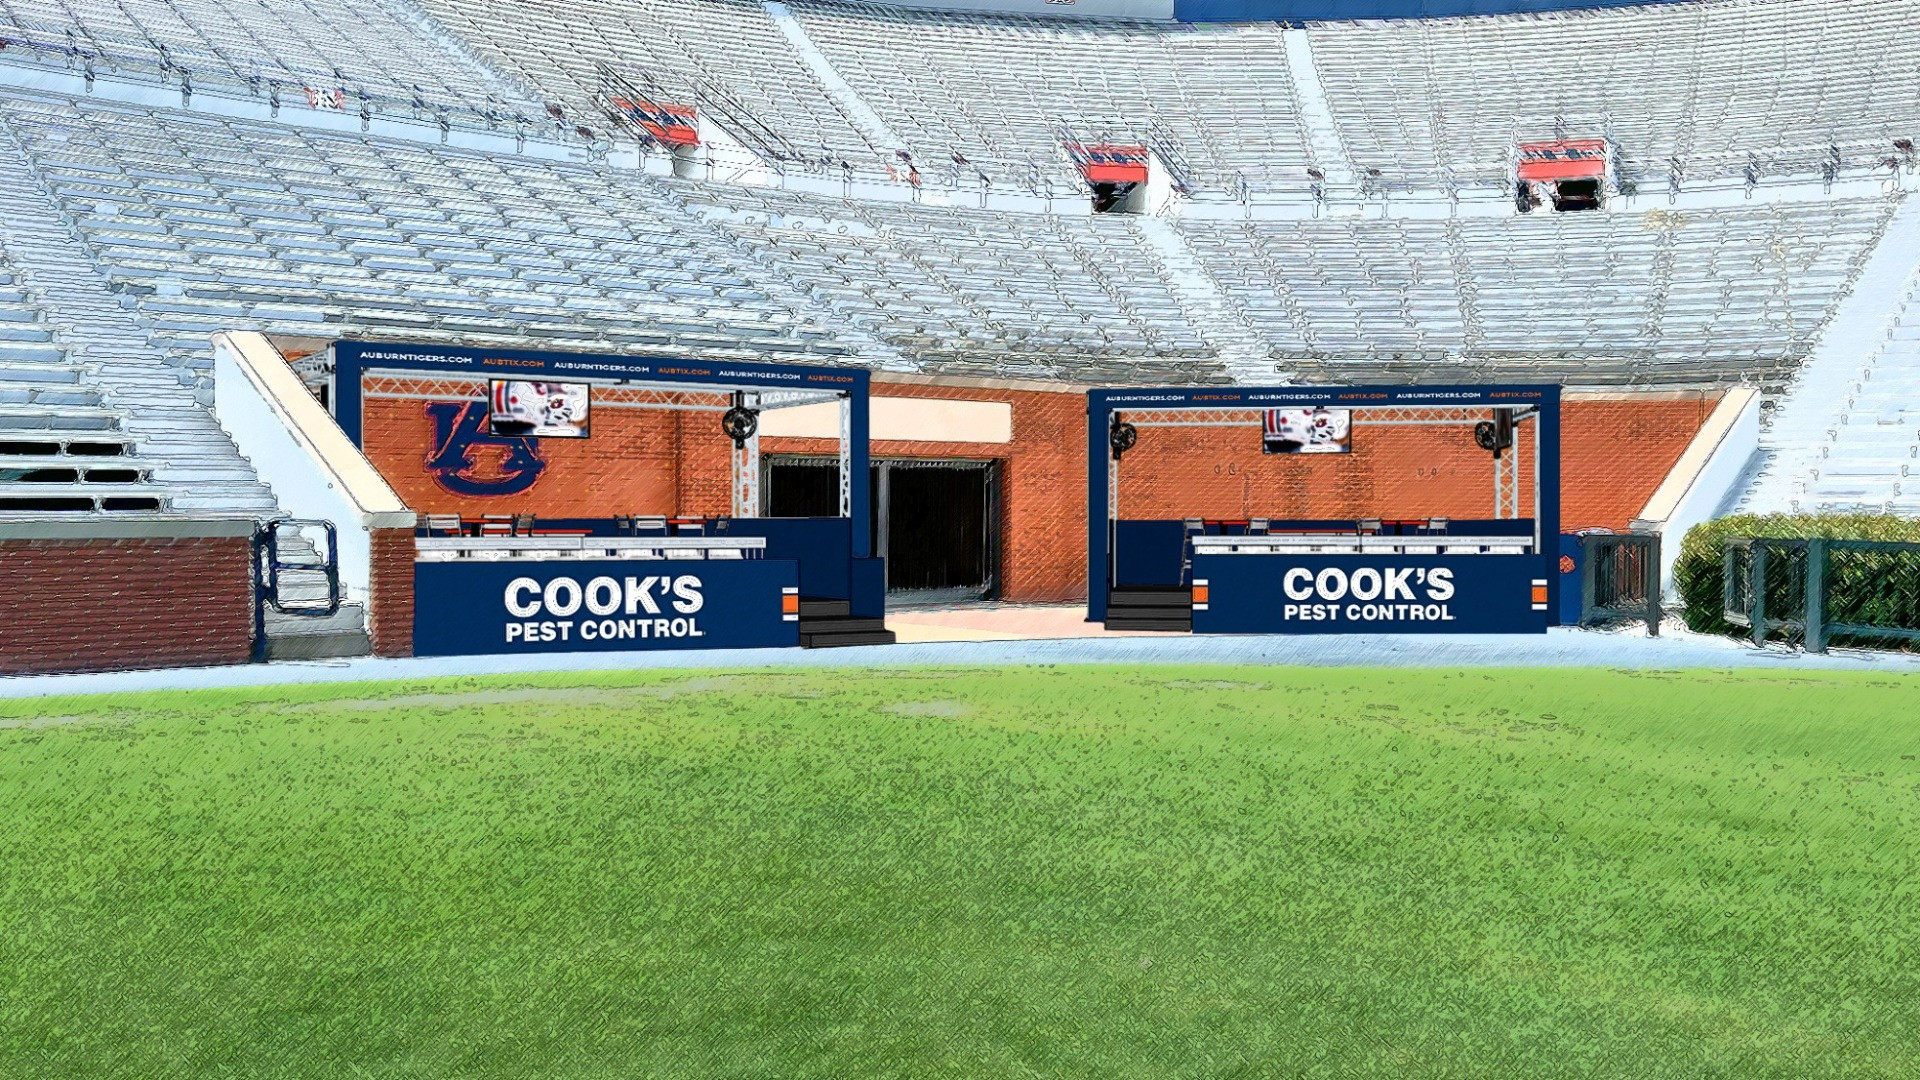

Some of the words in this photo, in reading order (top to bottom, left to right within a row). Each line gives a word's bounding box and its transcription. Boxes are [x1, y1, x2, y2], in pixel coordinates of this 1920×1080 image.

[359, 351, 472, 364] AUBURNTIGERS.COM
[482, 358, 545, 367] AUBTIX.COM
[554, 361, 650, 373] AUBURNTIGERS.COM
[658, 367, 711, 375] AUBTIX.COM
[718, 370, 801, 380] AUBURNTIGERS.COM
[505, 575, 703, 618] COOK'S
[1284, 568, 1454, 600] COOK'S
[1285, 604, 1340, 620] PEST
[1346, 604, 1453, 620] CONTROL
[506, 621, 573, 642] PEST
[581, 618, 702, 639] CONTROL
